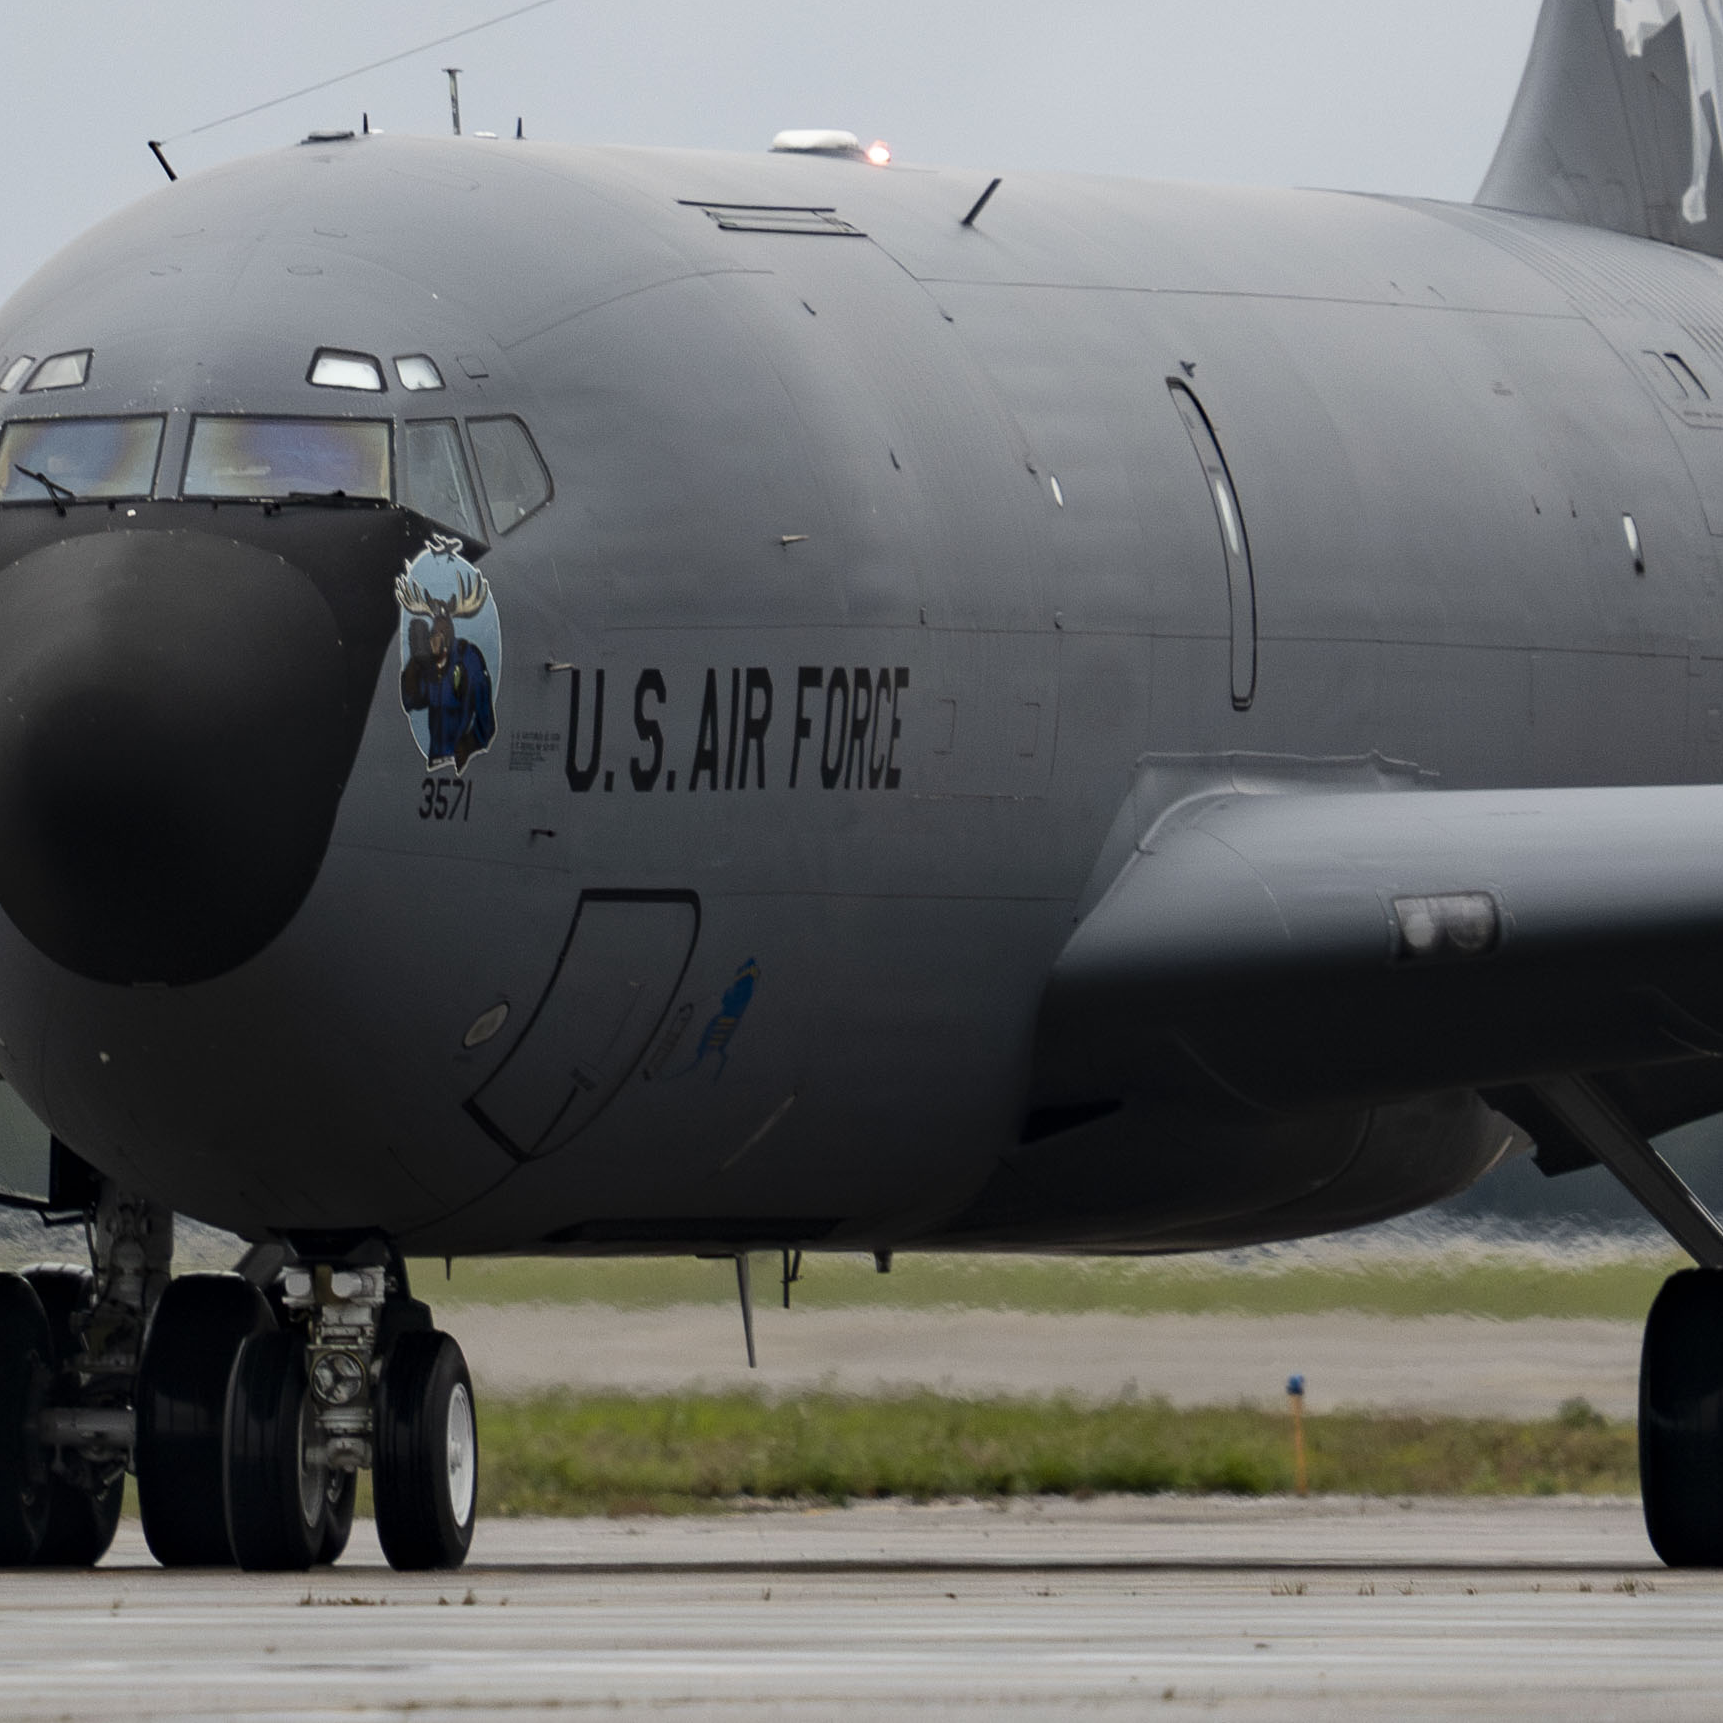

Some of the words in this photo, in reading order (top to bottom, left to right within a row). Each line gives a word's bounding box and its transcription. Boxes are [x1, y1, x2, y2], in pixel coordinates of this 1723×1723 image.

[689, 667, 773, 791] AIR
[789, 666, 910, 790] FORCE
[419, 778, 472, 821] 3571
